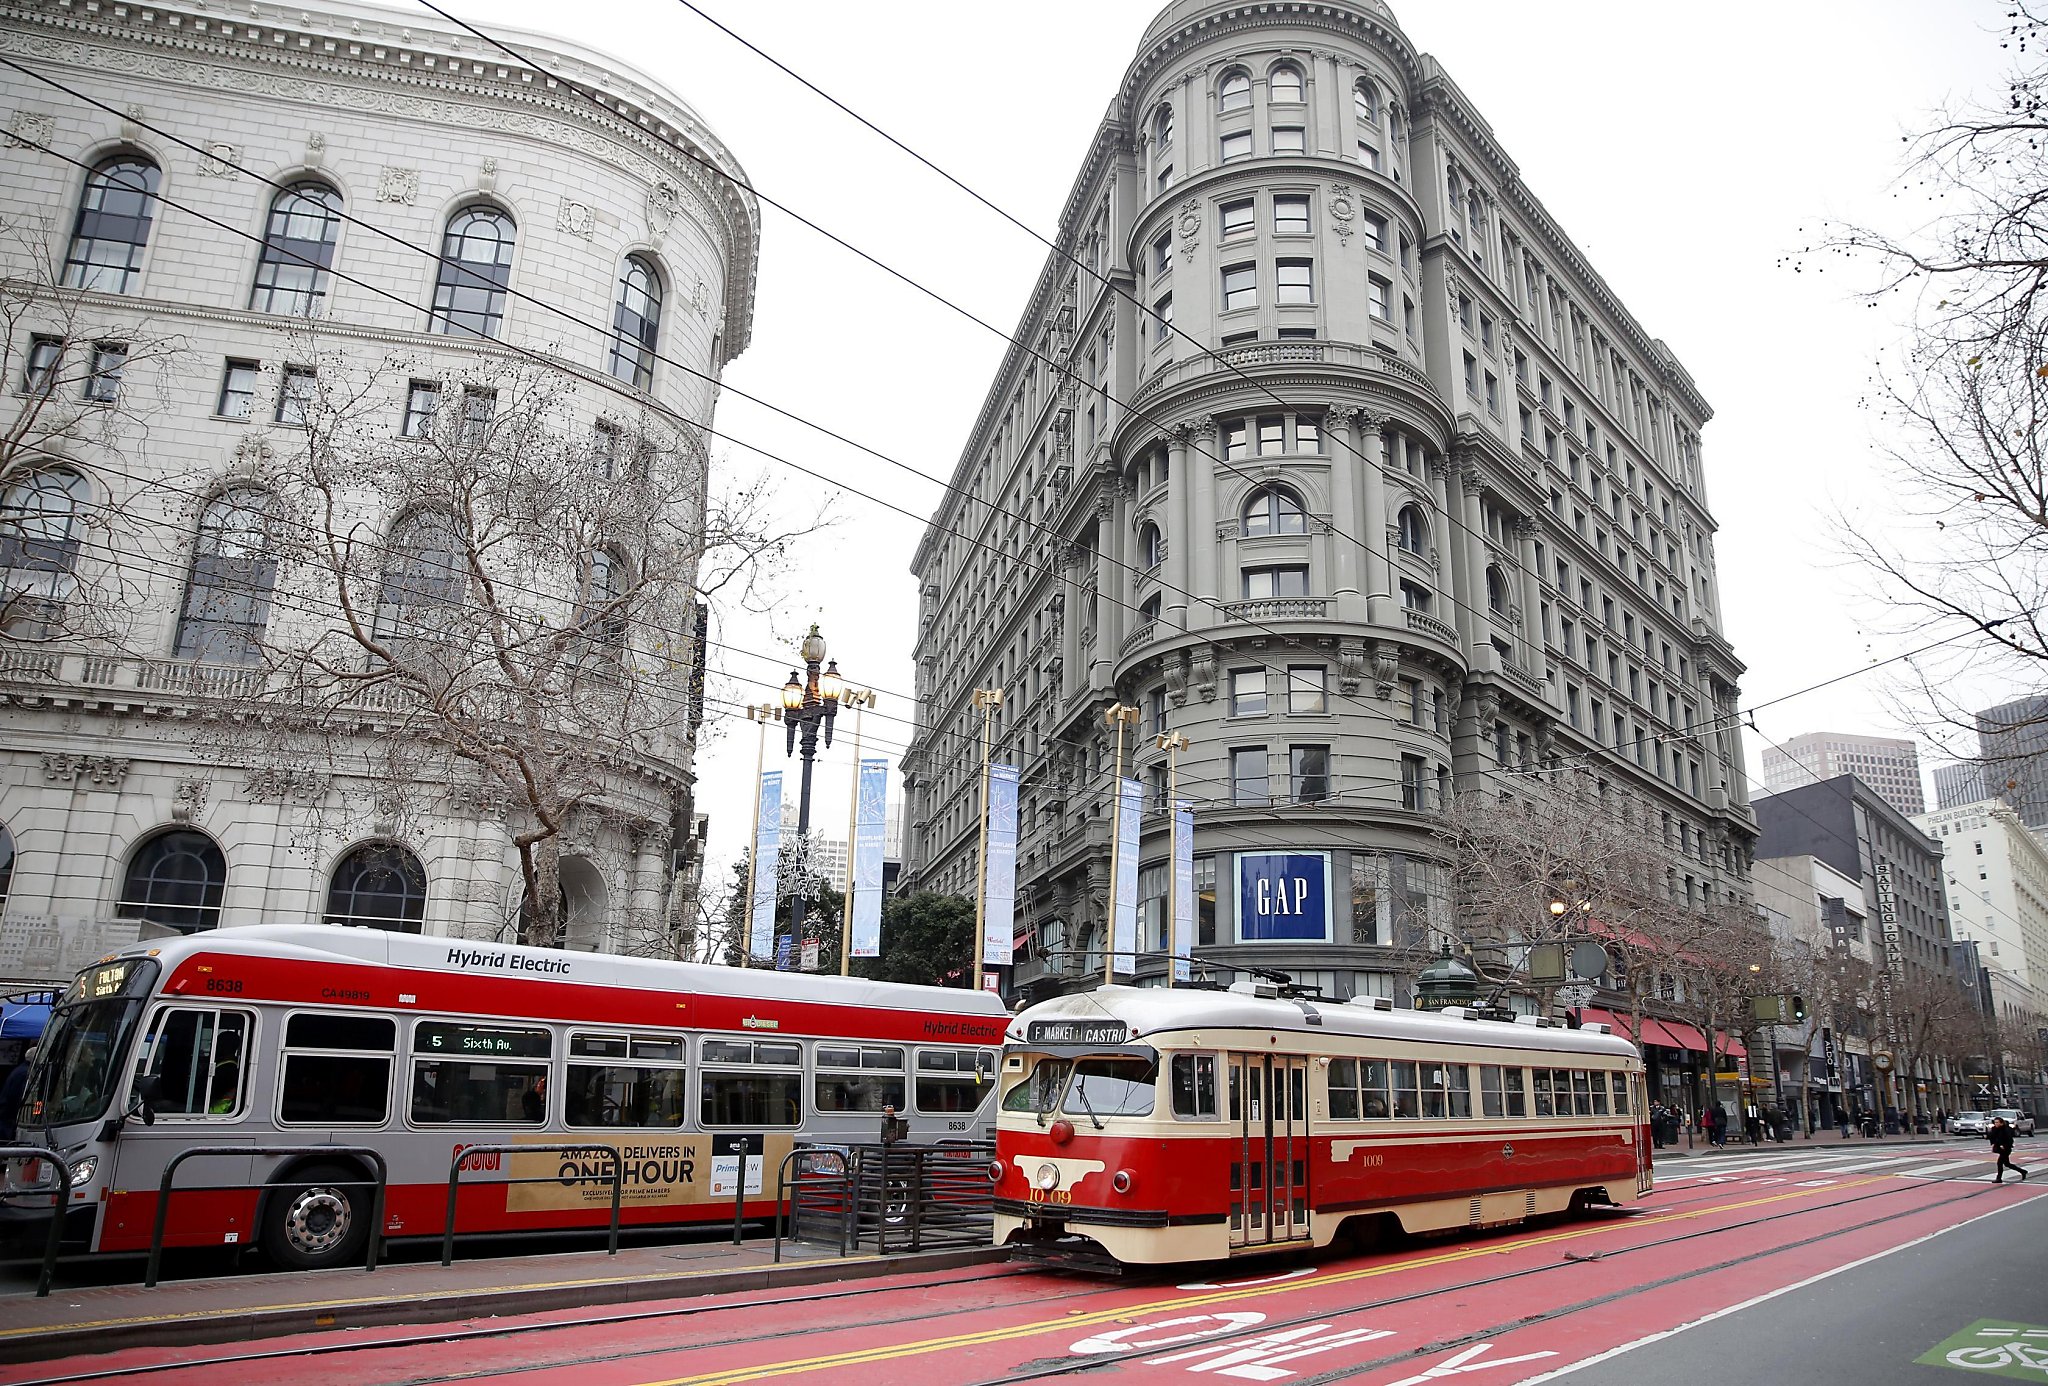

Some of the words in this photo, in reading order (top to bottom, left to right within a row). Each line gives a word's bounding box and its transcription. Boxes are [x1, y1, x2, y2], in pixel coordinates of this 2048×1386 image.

[1257, 877, 1308, 916] GAP
[446, 948, 505, 969] Hybrid
[509, 954, 571, 974] Electric
[80, 976, 86, 999] 5
[98, 966, 124, 985] FULTON
[206, 978, 243, 993] 8638
[923, 1020, 957, 1036] Hybrid
[960, 1023, 997, 1038] Electric
[1035, 1026, 1041, 1040] F
[1044, 1026, 1074, 1040] MARKET
[1085, 1028, 1126, 1043] CASTRO
[432, 1036, 443, 1047] 5
[463, 1037, 494, 1049] Sixth
[496, 1039, 512, 1050] Av.
[1824, 1040, 1833, 1066] ALDO
[948, 1121, 966, 1131] 8638
[623, 1147, 680, 1159] DELIVERS
[683, 1146, 696, 1157] IN
[1363, 1154, 1383, 1168] 1009
[558, 1161, 614, 1187] ONE
[622, 1160, 695, 1185] HOUR
